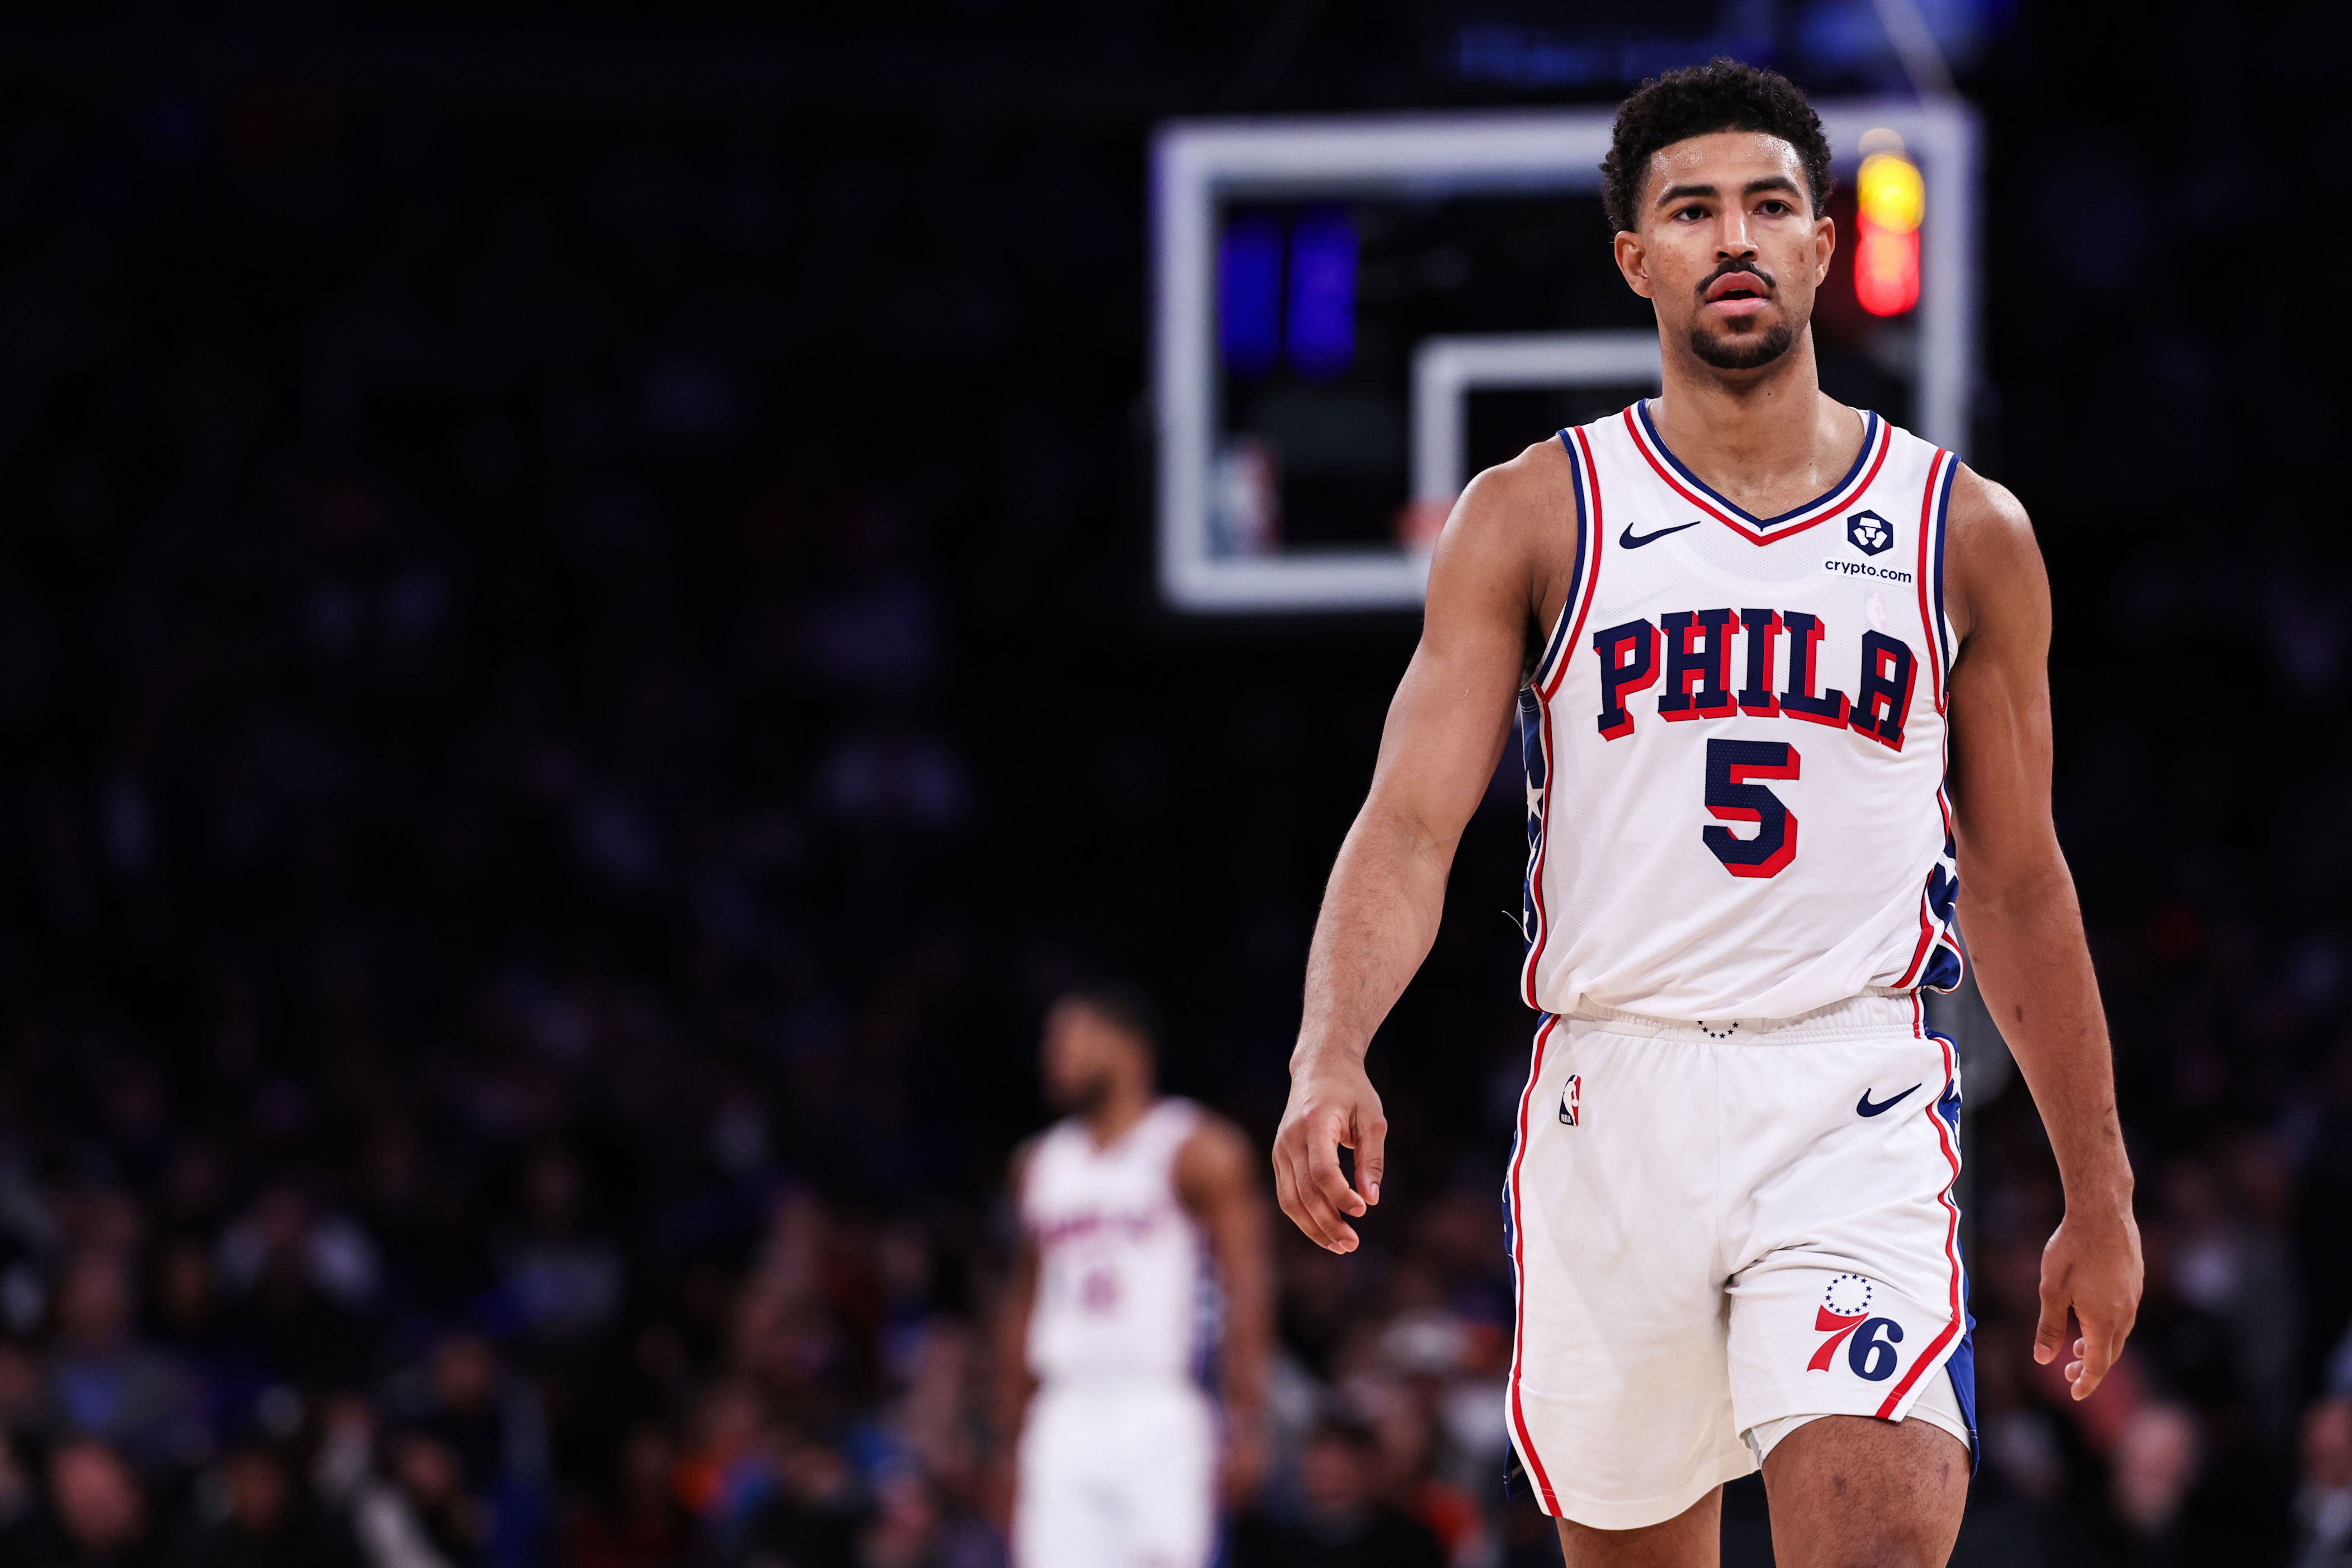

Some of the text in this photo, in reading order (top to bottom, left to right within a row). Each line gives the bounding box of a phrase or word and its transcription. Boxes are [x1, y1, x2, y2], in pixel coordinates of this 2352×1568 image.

[1825, 561, 1911, 583] crypto.com
[1593, 608, 1918, 753] PHILA
[1703, 738, 1801, 878] 5
[1561, 1113, 1571, 1123] NBA
[1807, 1305, 1904, 1381] 76
